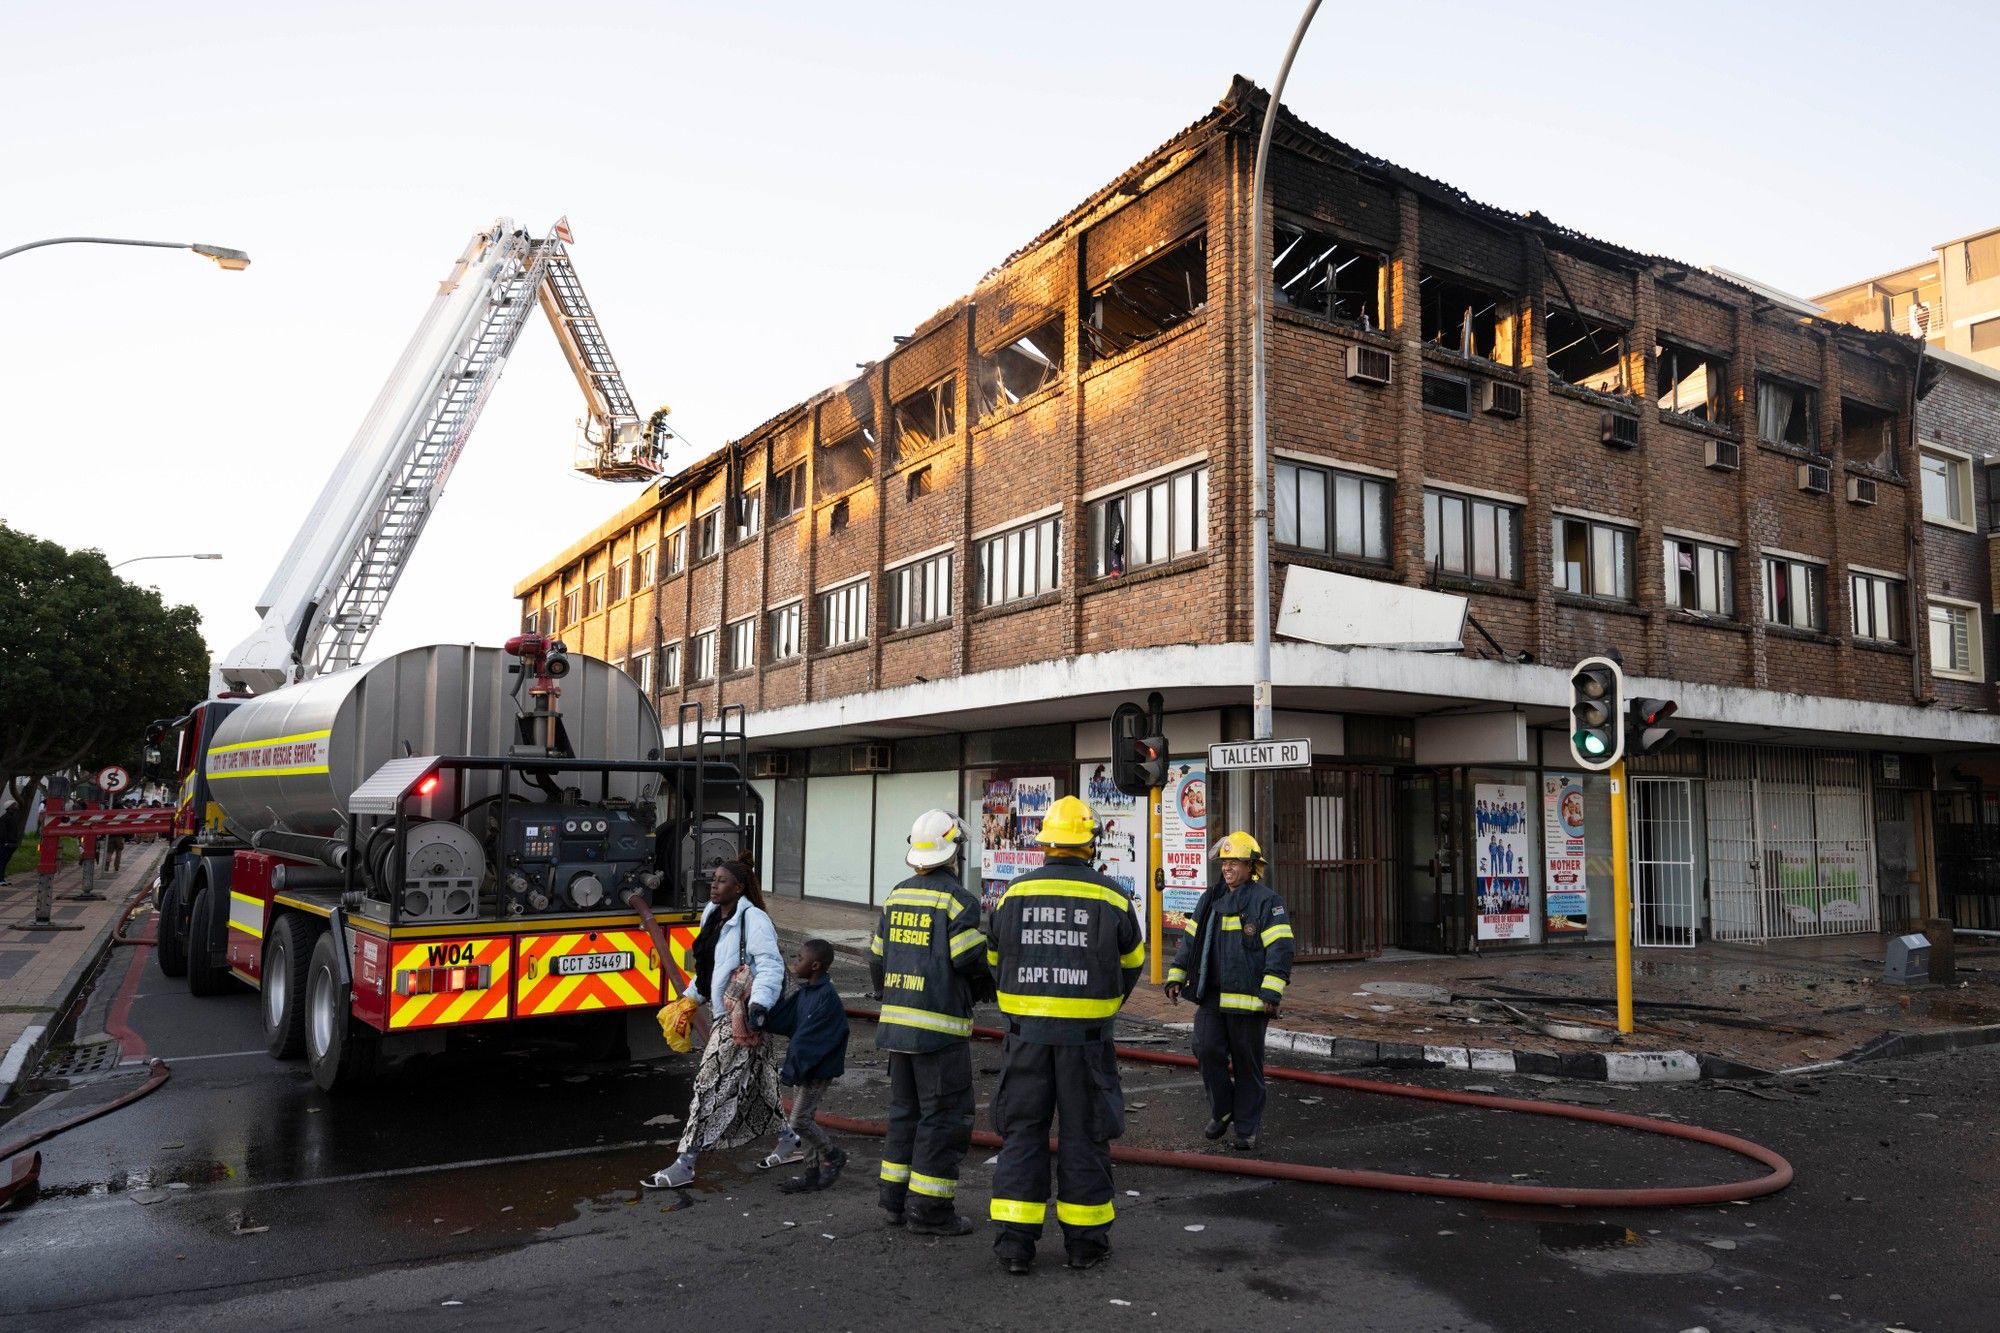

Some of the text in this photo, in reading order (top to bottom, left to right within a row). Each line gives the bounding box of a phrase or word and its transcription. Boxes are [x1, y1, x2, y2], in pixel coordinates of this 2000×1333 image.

[213, 742, 317, 771] CITY OF CAPE TOWN FIRE AND RESCUE SERVICE
[1220, 745, 1299, 765] TALLENT RD
[993, 851, 1046, 867] MOTHER OF NATION
[1167, 852, 1202, 865] MOTHER
[1550, 860, 1582, 871] MOTHER
[996, 864, 1015, 875] ACADEMY
[890, 911, 932, 928] FIRE &
[1022, 907, 1089, 925] FIRE &
[889, 927, 931, 946] RESCUE
[1020, 928, 1089, 947] RESCUE
[428, 943, 474, 966] W04
[562, 954, 621, 972] CCT 35449
[902, 974, 926, 992] TOWN
[1017, 967, 1088, 985] CAPE TOWN
